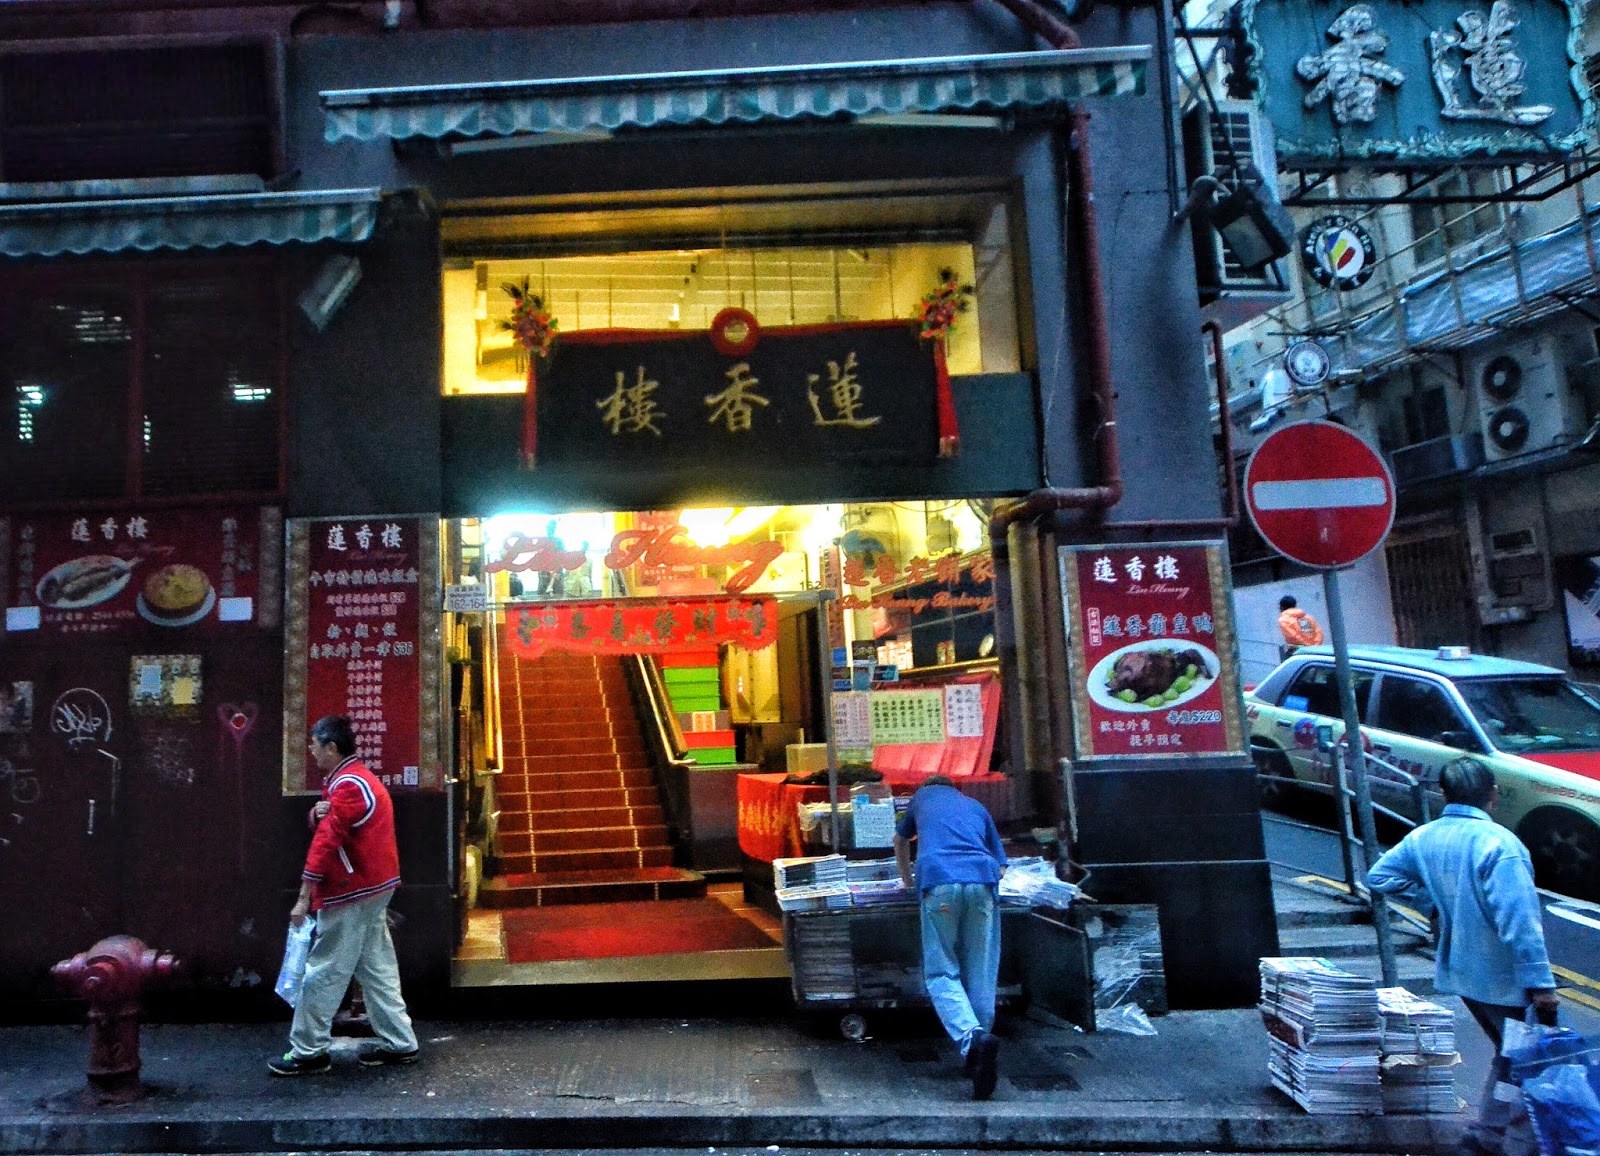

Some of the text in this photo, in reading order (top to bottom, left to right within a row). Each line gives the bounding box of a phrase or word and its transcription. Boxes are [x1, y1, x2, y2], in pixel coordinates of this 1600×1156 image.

[327, 522, 403, 551] 蓮香樓
[1092, 555, 1180, 583] 蓮香樓
[1126, 583, 1190, 598] Lin Heung
[1100, 718, 1152, 733] 歡迎外賣
